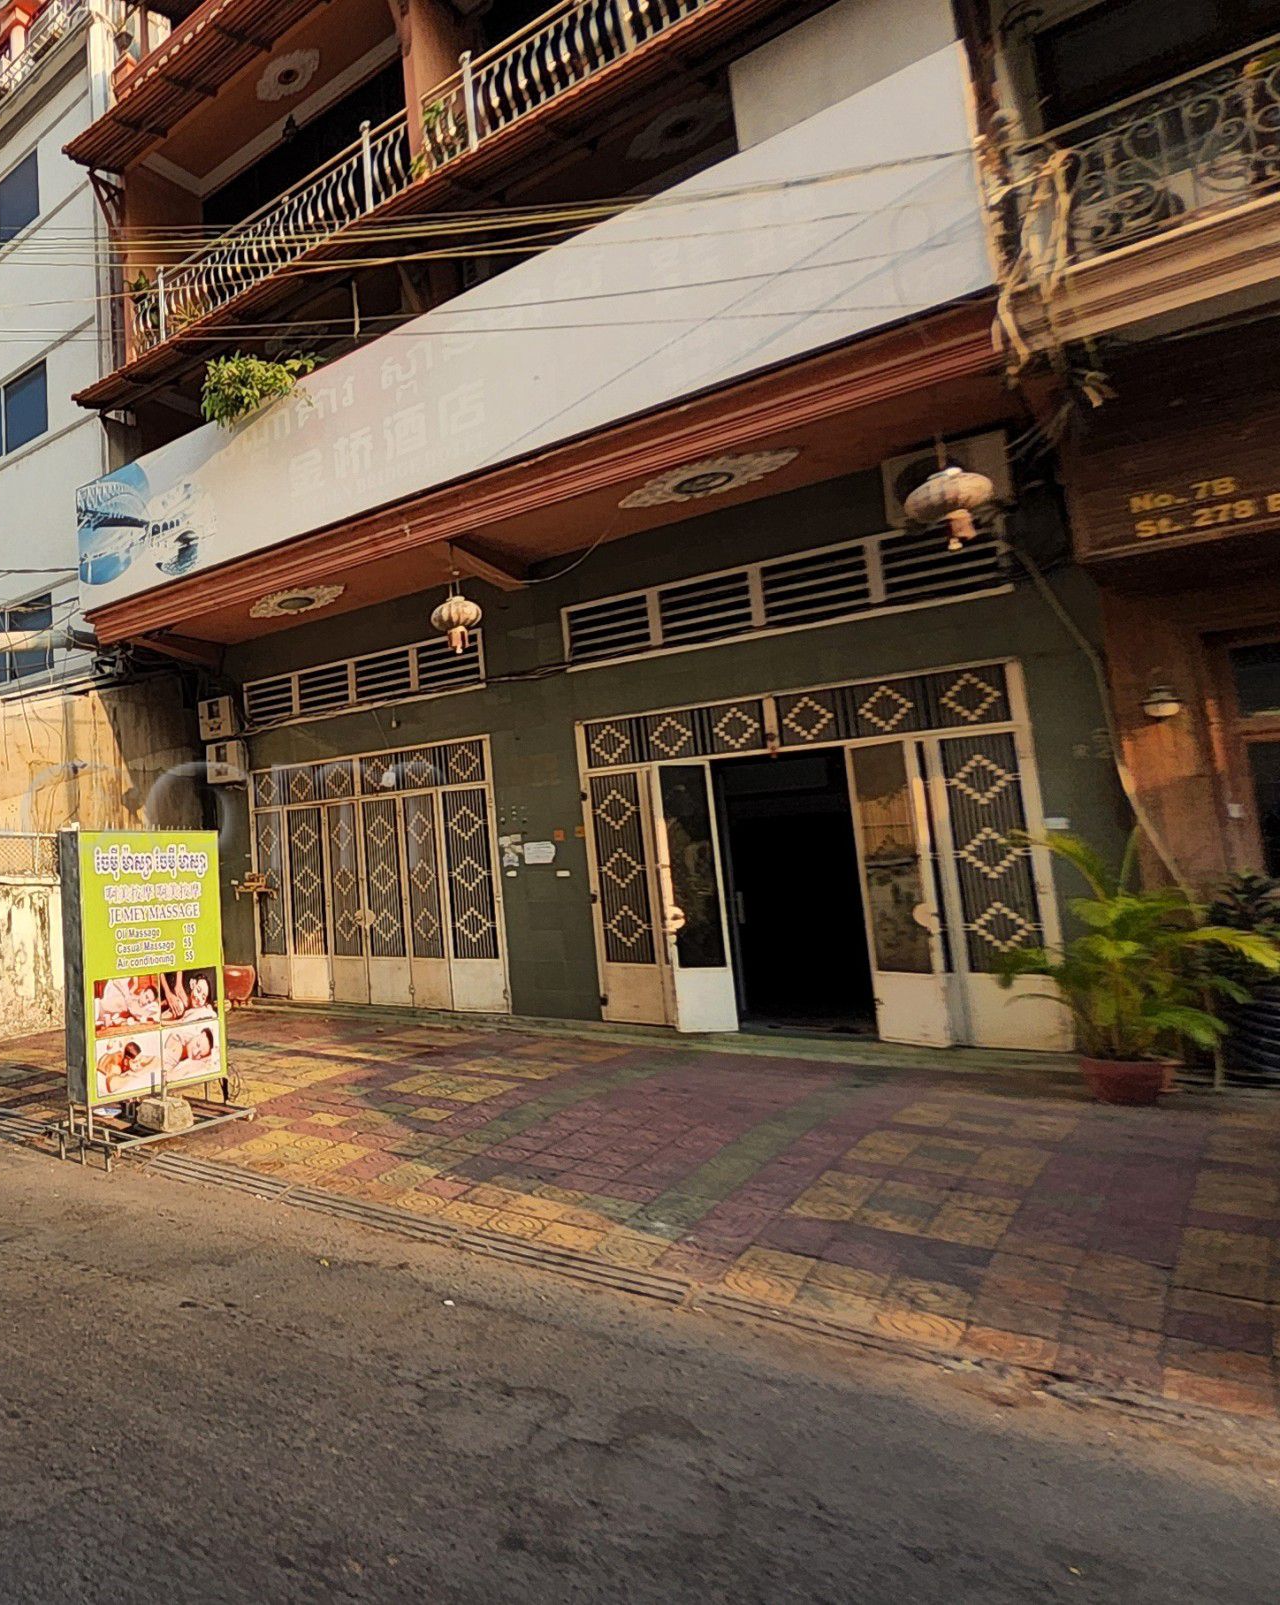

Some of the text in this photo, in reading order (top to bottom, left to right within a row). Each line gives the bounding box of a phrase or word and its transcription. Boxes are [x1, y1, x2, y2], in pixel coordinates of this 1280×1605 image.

[1192, 499, 1257, 527] 278
[109, 903, 199, 925] JE MEY MASSAGE
[128, 928, 161, 939] Massage
[143, 941, 175, 952] Massage
[117, 958, 129, 969] Air
[130, 955, 175, 967] conditioning
